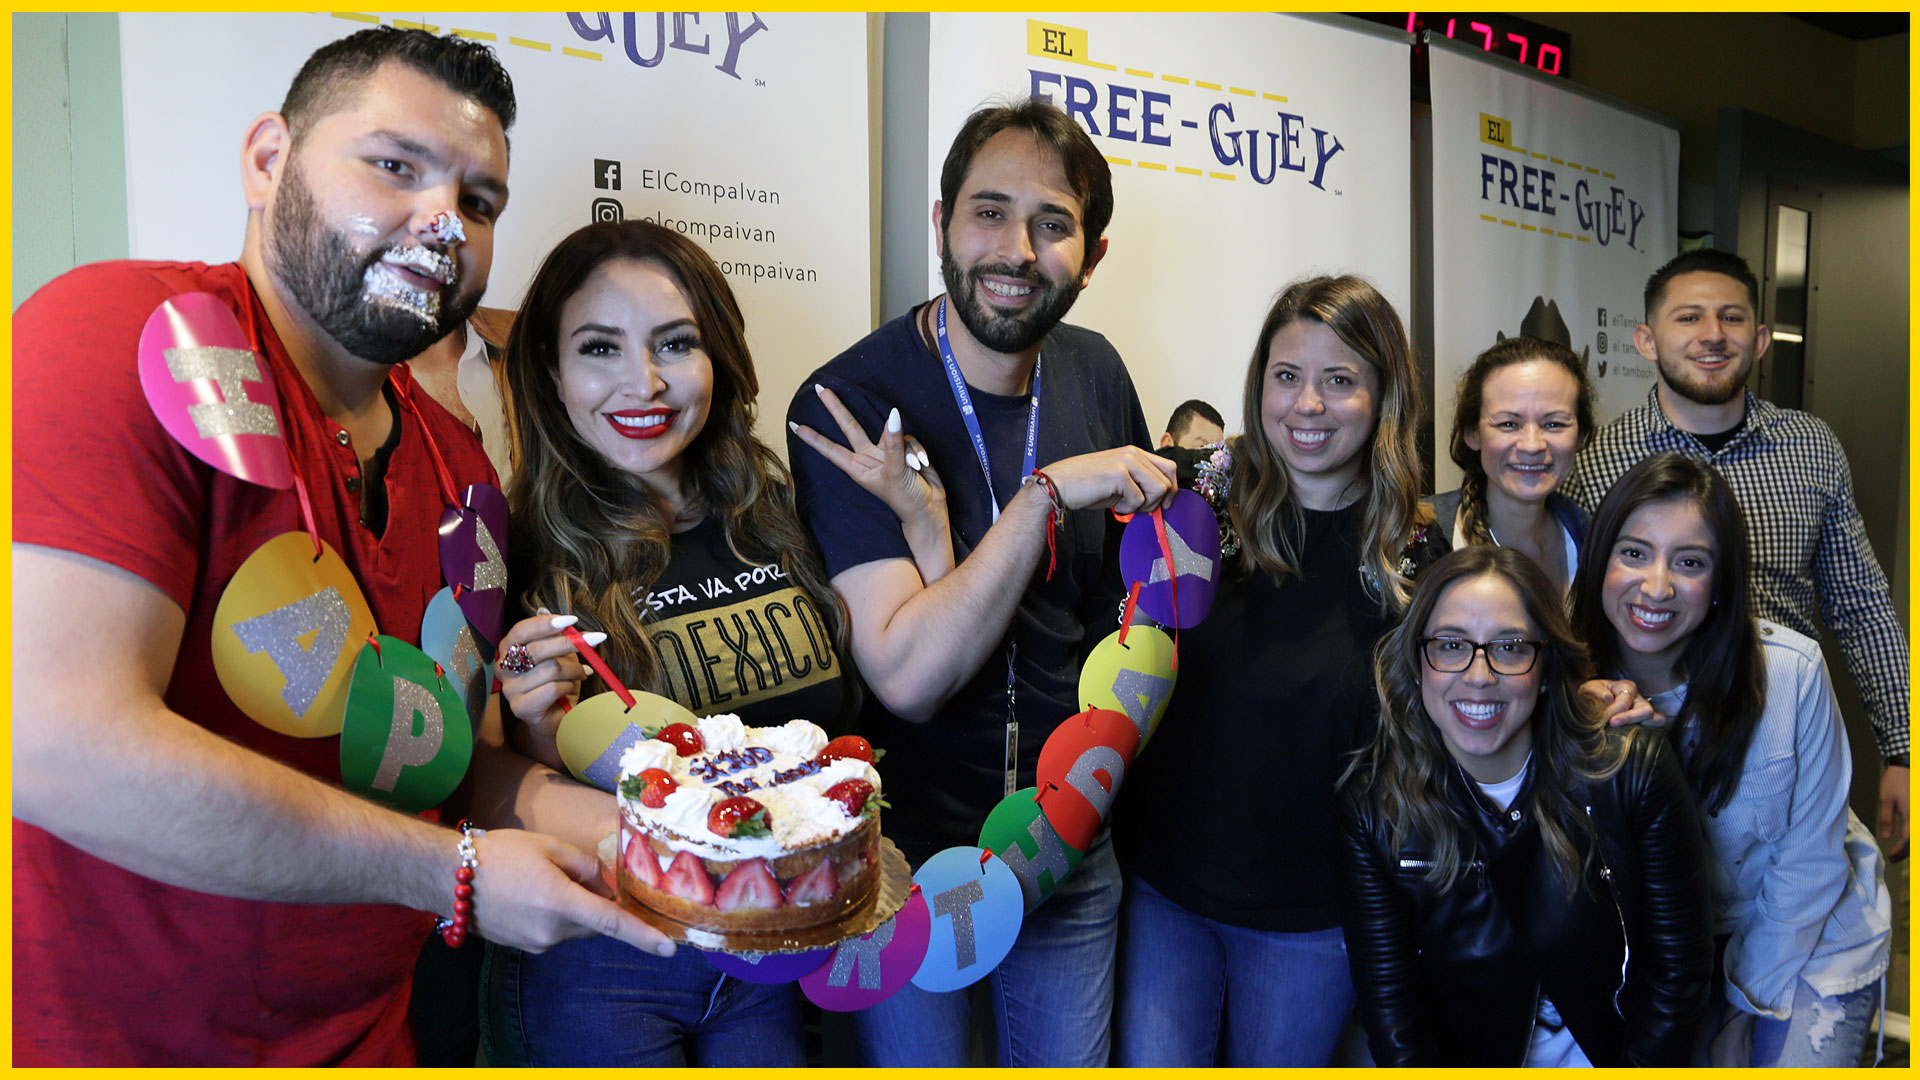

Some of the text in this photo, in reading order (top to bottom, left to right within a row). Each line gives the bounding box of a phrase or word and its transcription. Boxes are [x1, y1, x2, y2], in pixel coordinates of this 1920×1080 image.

[1042, 28, 1073, 57] EL
[754, 78, 766, 88] SM
[1487, 119, 1505, 144] EL
[946, 354, 968, 405] UNIVISION 34
[1027, 407, 1036, 447] UNIVISION
[698, 577, 733, 600] VA
[735, 563, 789, 592] POR
